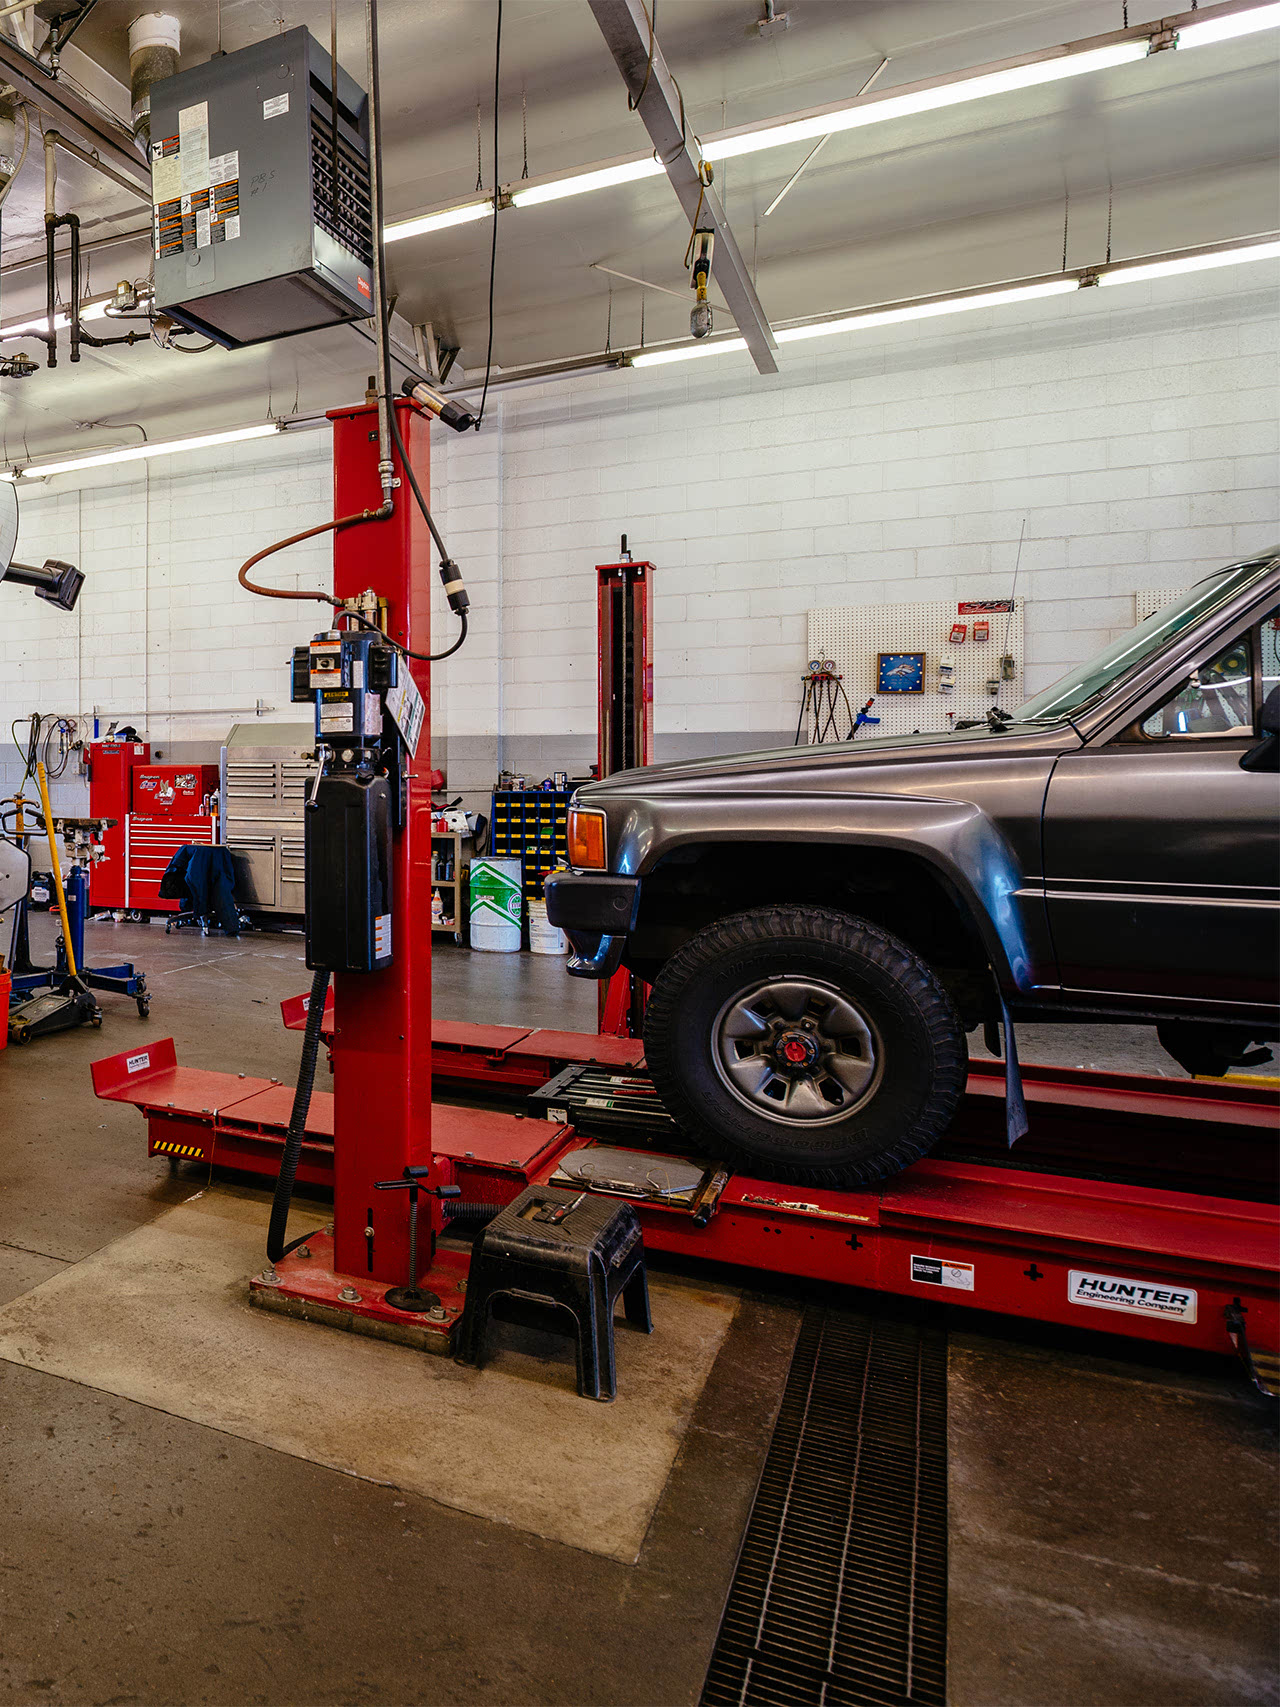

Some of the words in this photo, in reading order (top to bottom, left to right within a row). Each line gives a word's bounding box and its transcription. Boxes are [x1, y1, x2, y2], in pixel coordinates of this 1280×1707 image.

[129, 1055, 148, 1066] HUNTER
[1076, 1287, 1135, 1306] Engineering
[1136, 1297, 1187, 1314] Company
[1078, 1277, 1191, 1307] HUNTER
